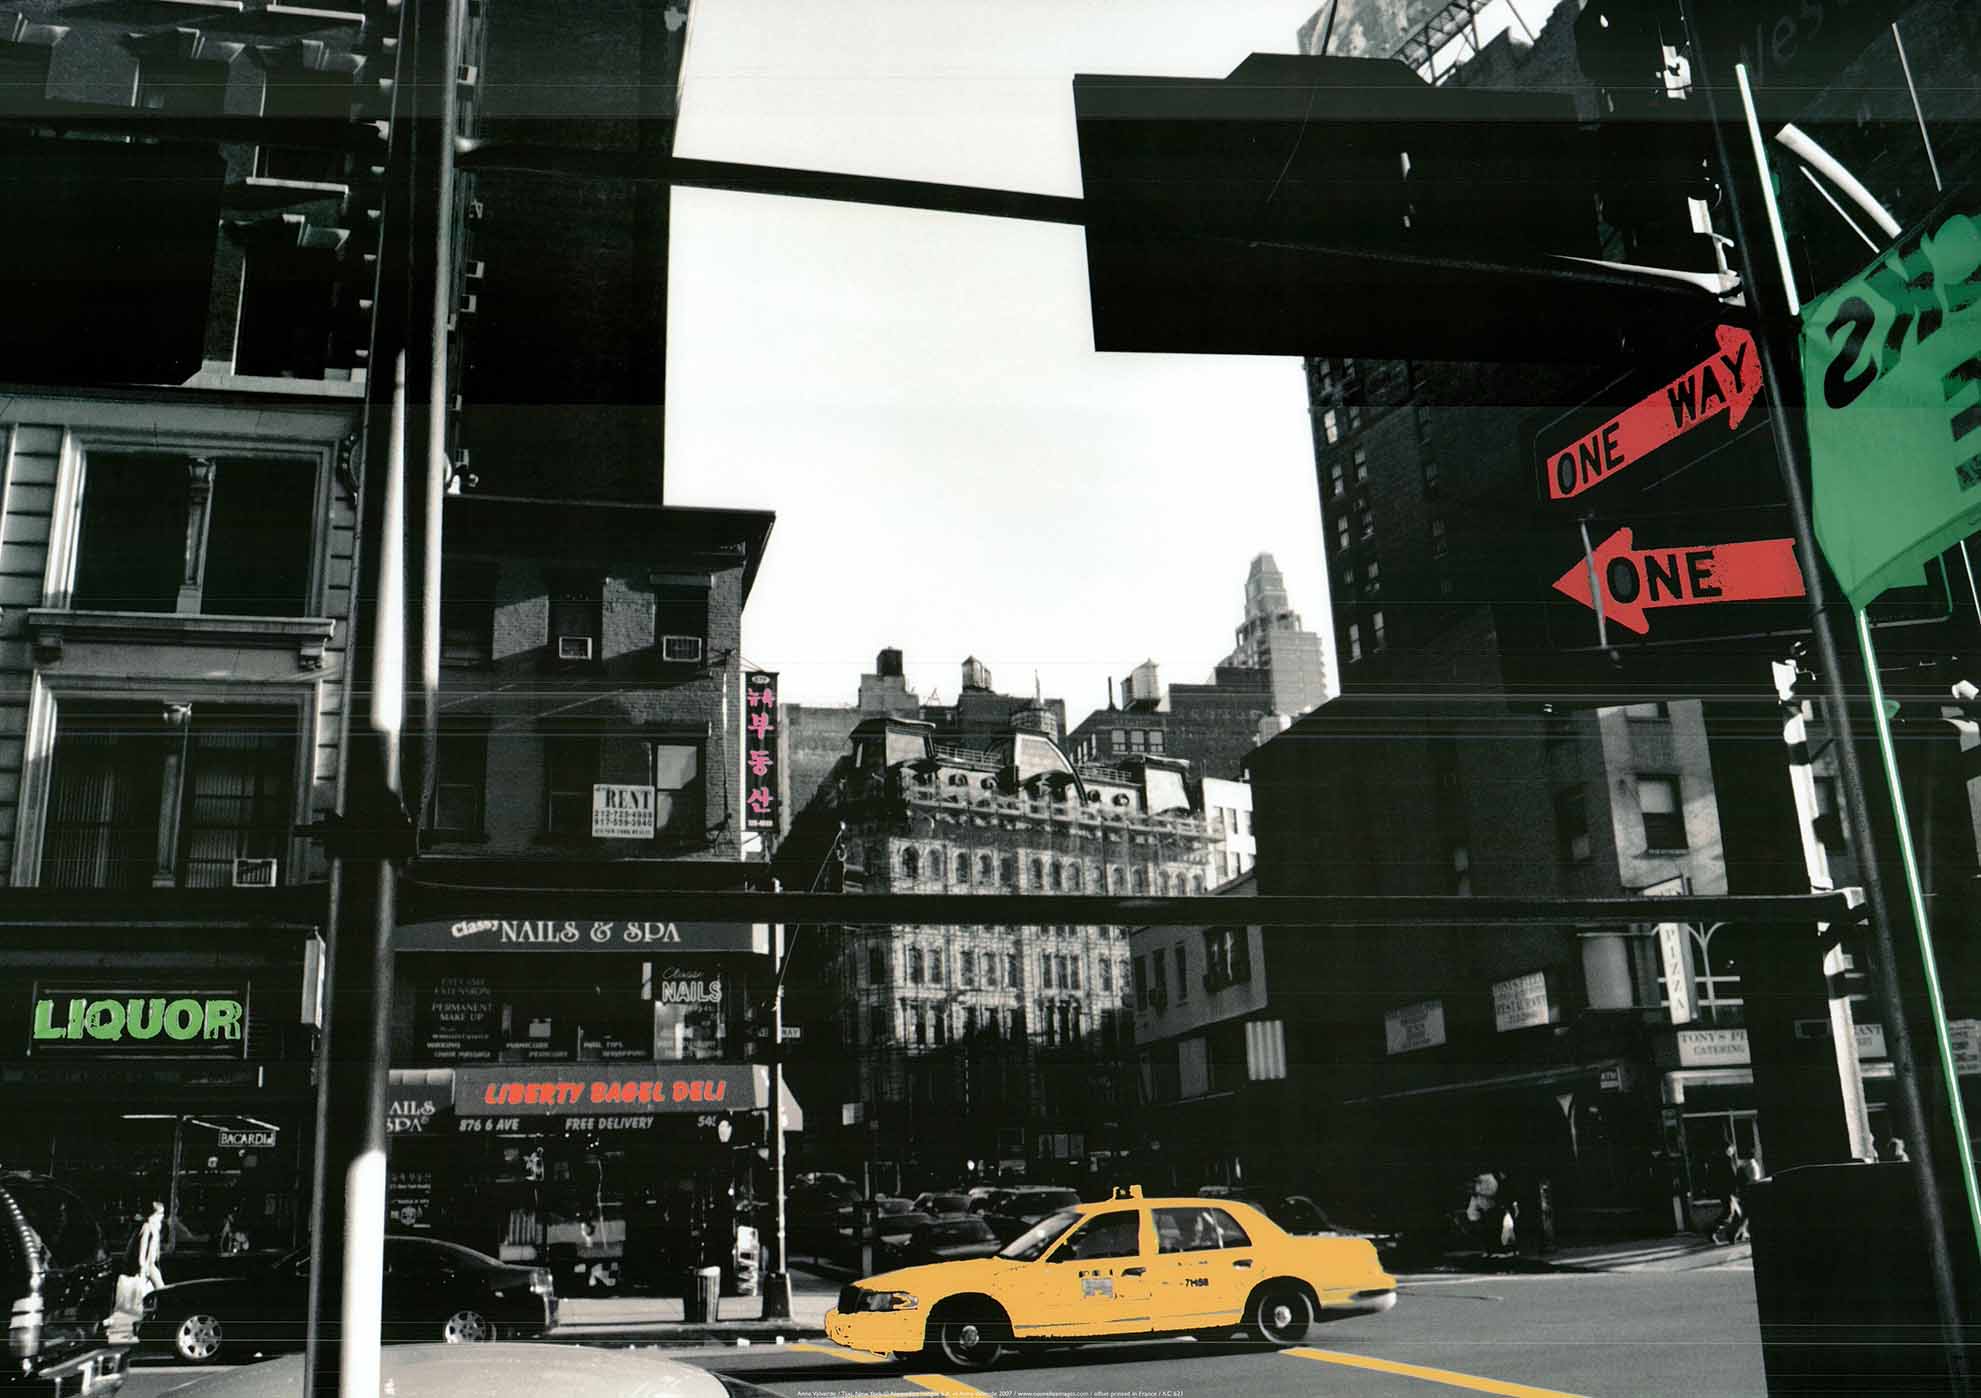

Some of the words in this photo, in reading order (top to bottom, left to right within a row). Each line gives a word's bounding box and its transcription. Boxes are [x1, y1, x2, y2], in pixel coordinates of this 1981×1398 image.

[1557, 421, 1625, 492] ONE
[1667, 342, 1748, 429] WAY
[1606, 549, 1723, 604] ONE
[606, 787, 652, 809] RENT
[451, 919, 499, 938] Classy
[501, 920, 580, 943] NAILS
[590, 920, 614, 943] &
[623, 920, 681, 943] SPA
[1666, 928, 1685, 1009] PIZZA
[661, 980, 722, 1002] NAILS
[32, 998, 244, 1041] LIQUOR
[484, 1082, 585, 1105] LIBERTY
[590, 1080, 666, 1104] BAGEL
[671, 1079, 726, 1102] DELI
[389, 1101, 437, 1116] AILS
[459, 1119, 481, 1131] 876
[485, 1119, 493, 1130] 6
[496, 1118, 520, 1130] AVE
[565, 1118, 595, 1130] FREE
[598, 1117, 654, 1129] DELIVERY
